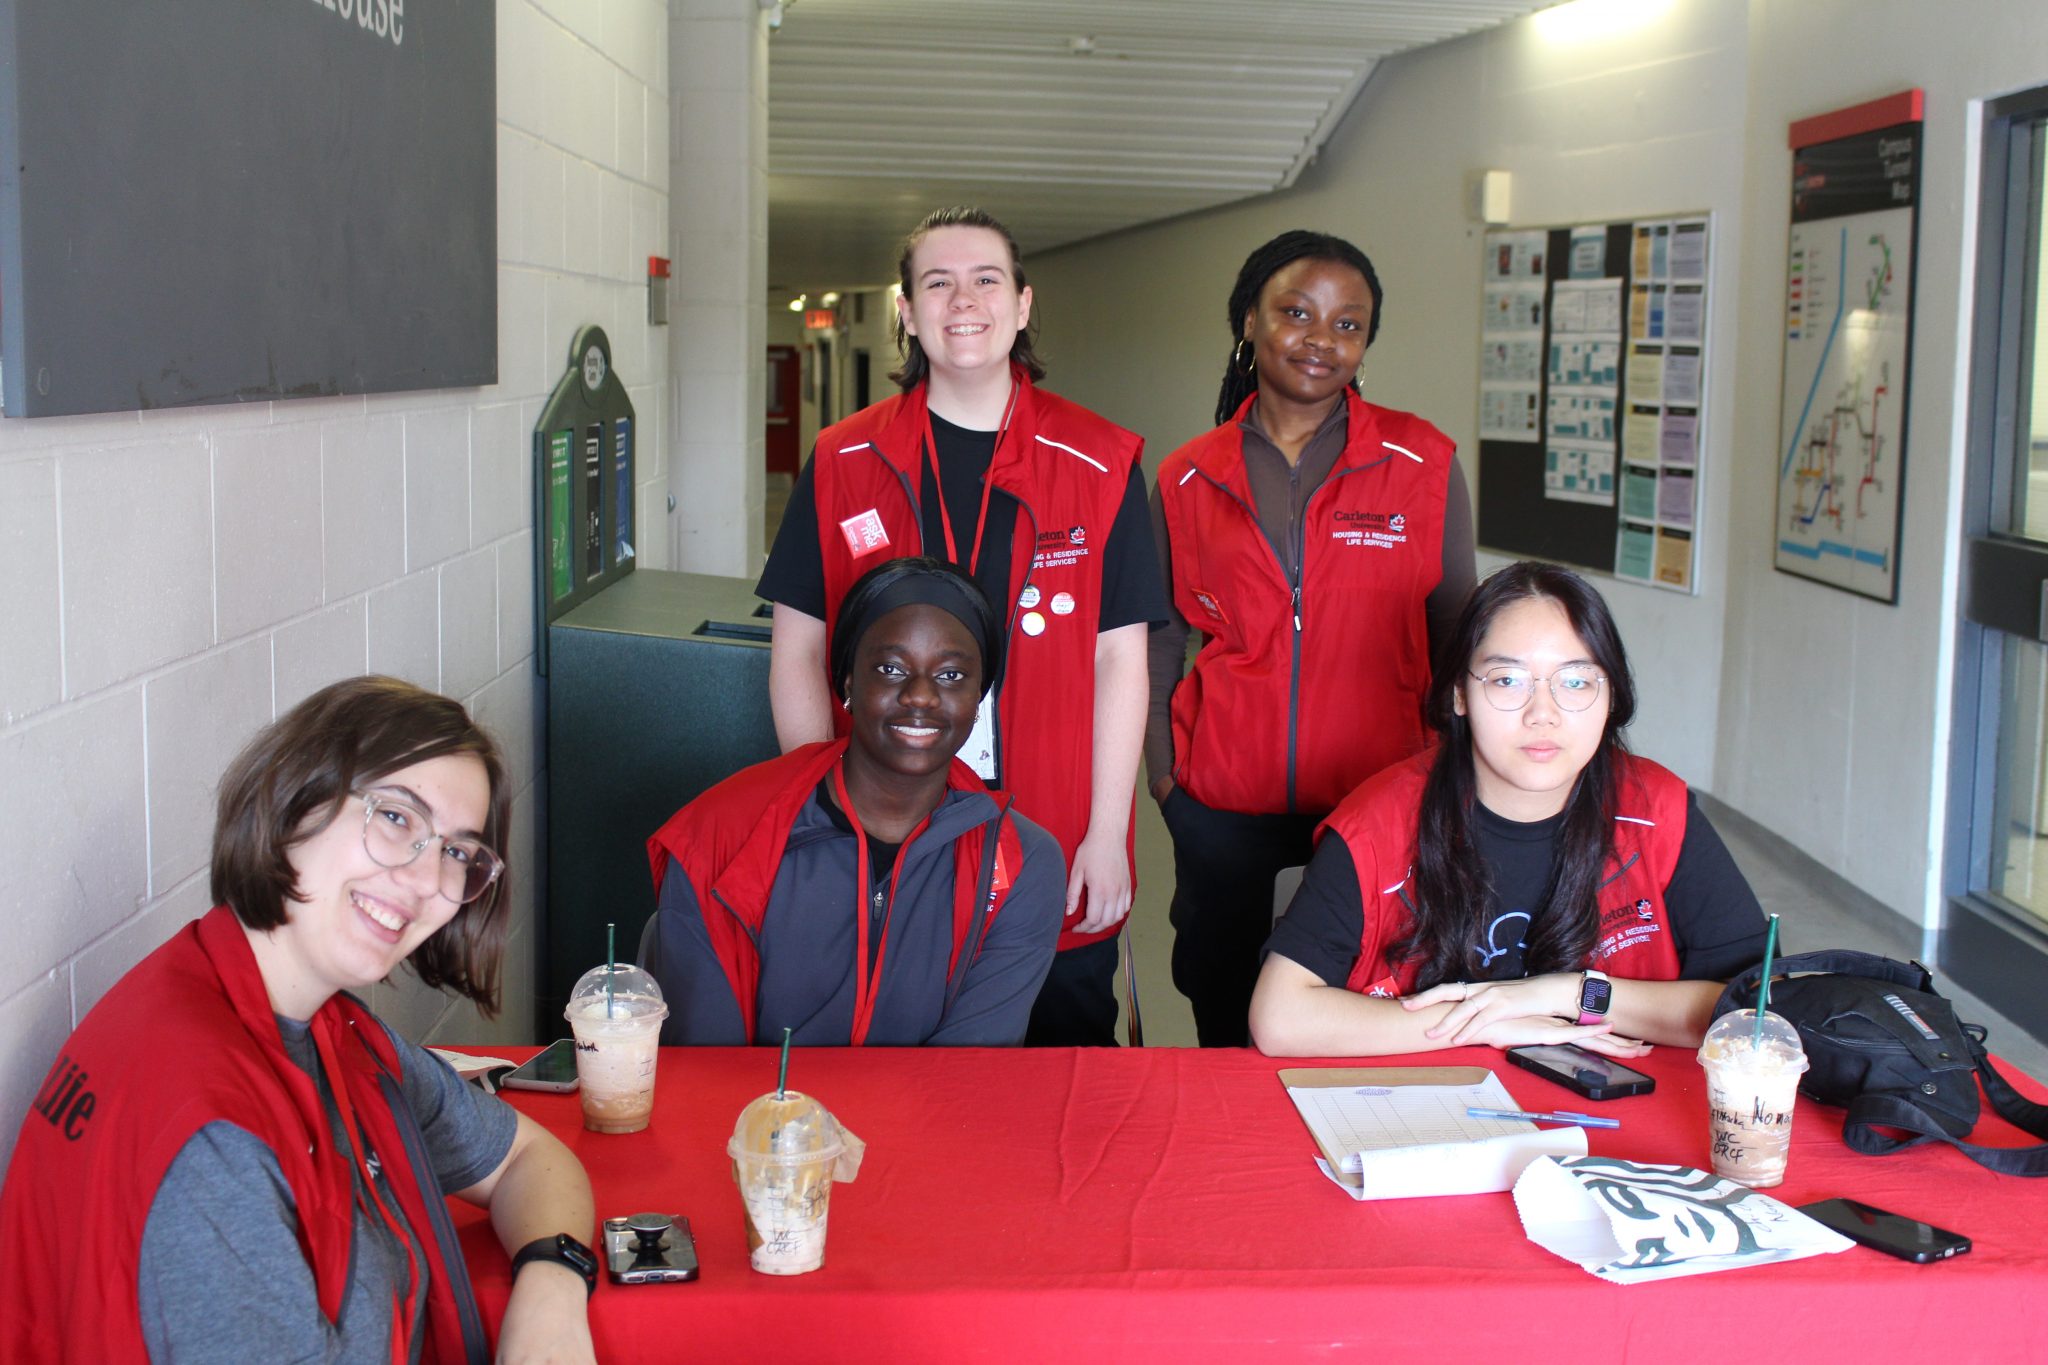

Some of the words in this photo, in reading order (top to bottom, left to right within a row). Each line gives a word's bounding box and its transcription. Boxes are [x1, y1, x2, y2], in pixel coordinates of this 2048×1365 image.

[1334, 511, 1385, 522] Carleton
[865, 518, 882, 542] ask
[1332, 531, 1363, 539] HOUSING
[1372, 532, 1406, 542] RESIDENCE
[1363, 539, 1392, 548] SERVICES
[1053, 548, 1088, 558] RESIDENCE
[1046, 557, 1076, 567] SERVICES
[1602, 945, 1618, 959] LIFE
